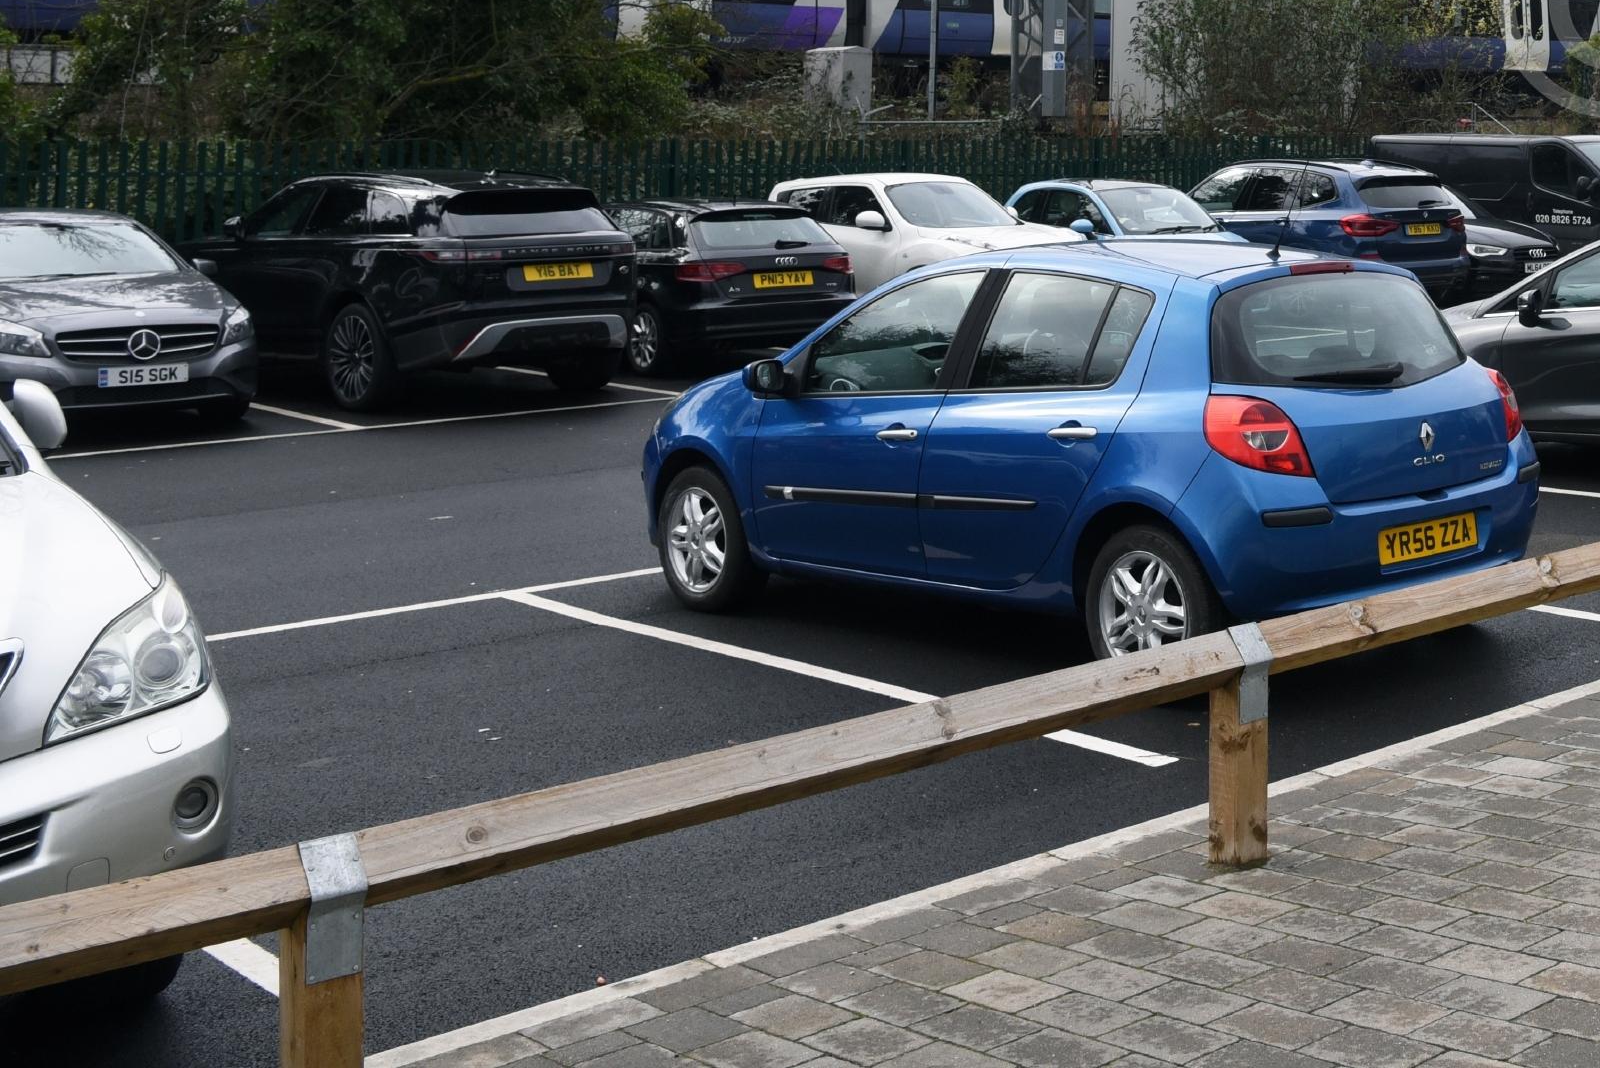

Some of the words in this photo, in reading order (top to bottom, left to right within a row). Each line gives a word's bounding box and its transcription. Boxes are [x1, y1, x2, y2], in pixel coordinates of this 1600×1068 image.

[1535, 214, 1550, 224] 020
[1551, 214, 1571, 225] 8826
[1572, 215, 1592, 226] 5724
[559, 263, 581, 278] BAT
[760, 273, 785, 286] PN13
[787, 272, 807, 284] YAV
[118, 369, 144, 385] S15
[148, 366, 178, 382] SGK
[1413, 453, 1446, 467] CLIO
[1384, 525, 1437, 559] YR56
[1439, 518, 1471, 548] ZZA
